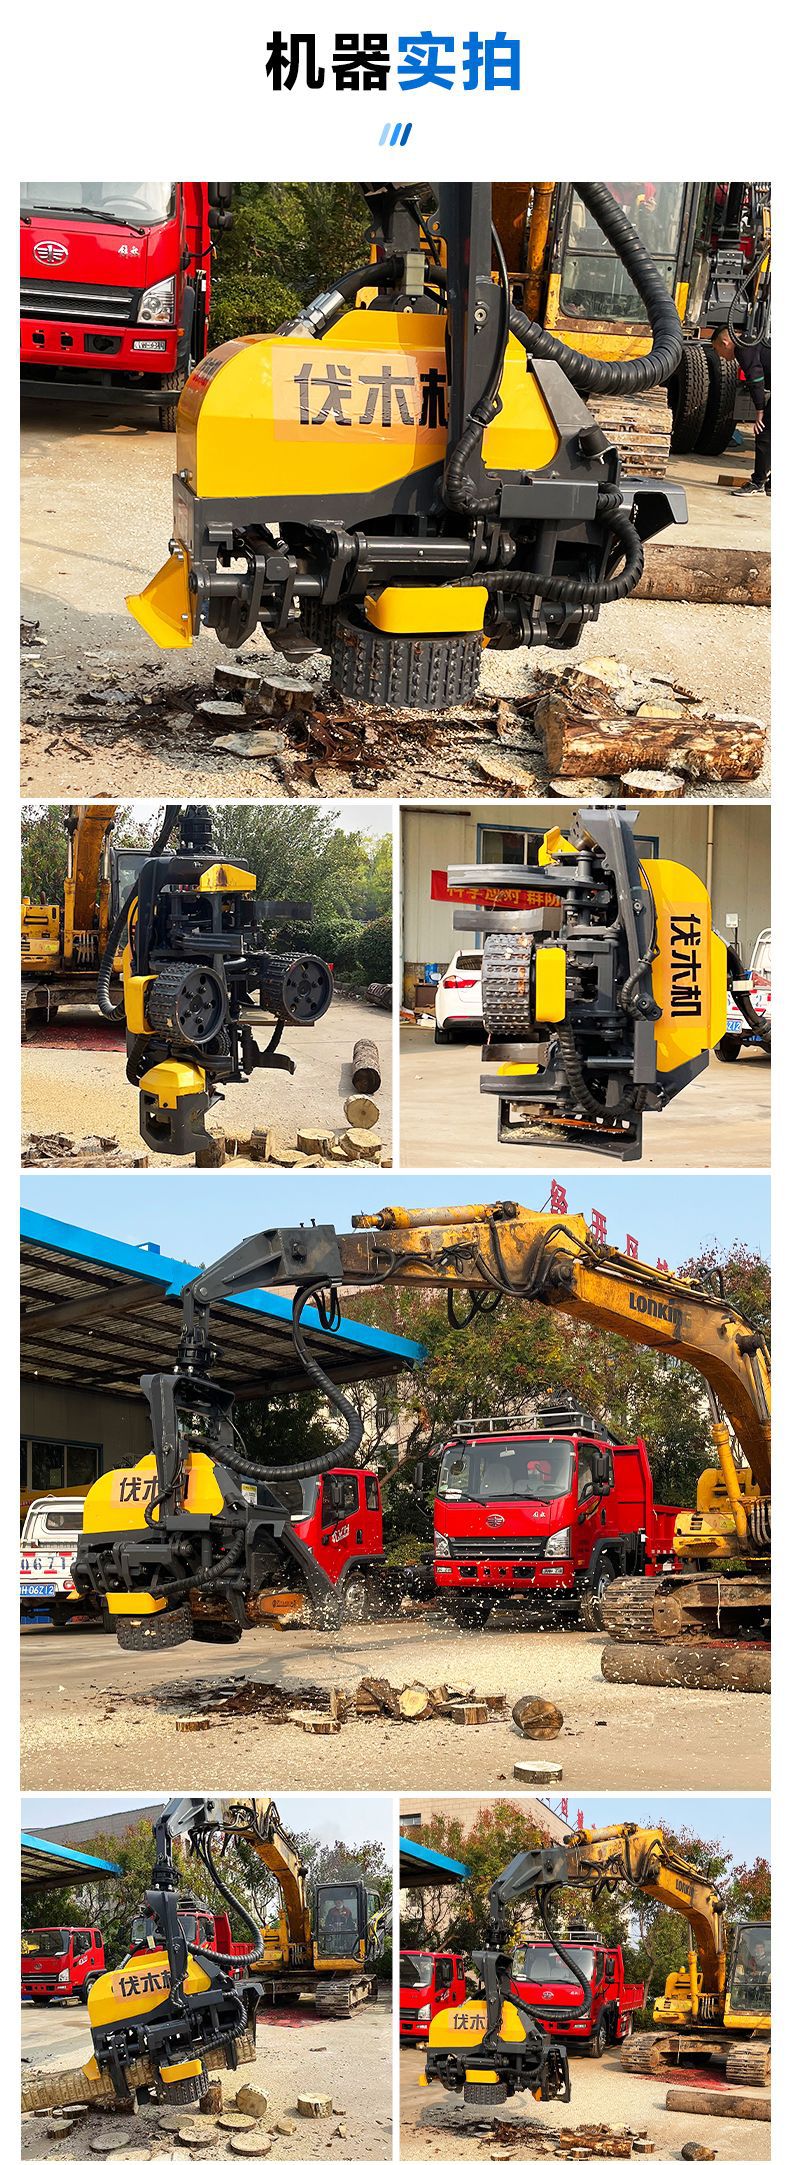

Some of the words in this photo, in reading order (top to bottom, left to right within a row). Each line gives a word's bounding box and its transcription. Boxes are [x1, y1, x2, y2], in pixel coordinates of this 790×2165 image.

[670, 913, 702, 1018] 伏木机
[20, 1584, 55, 1596] H06Z12
